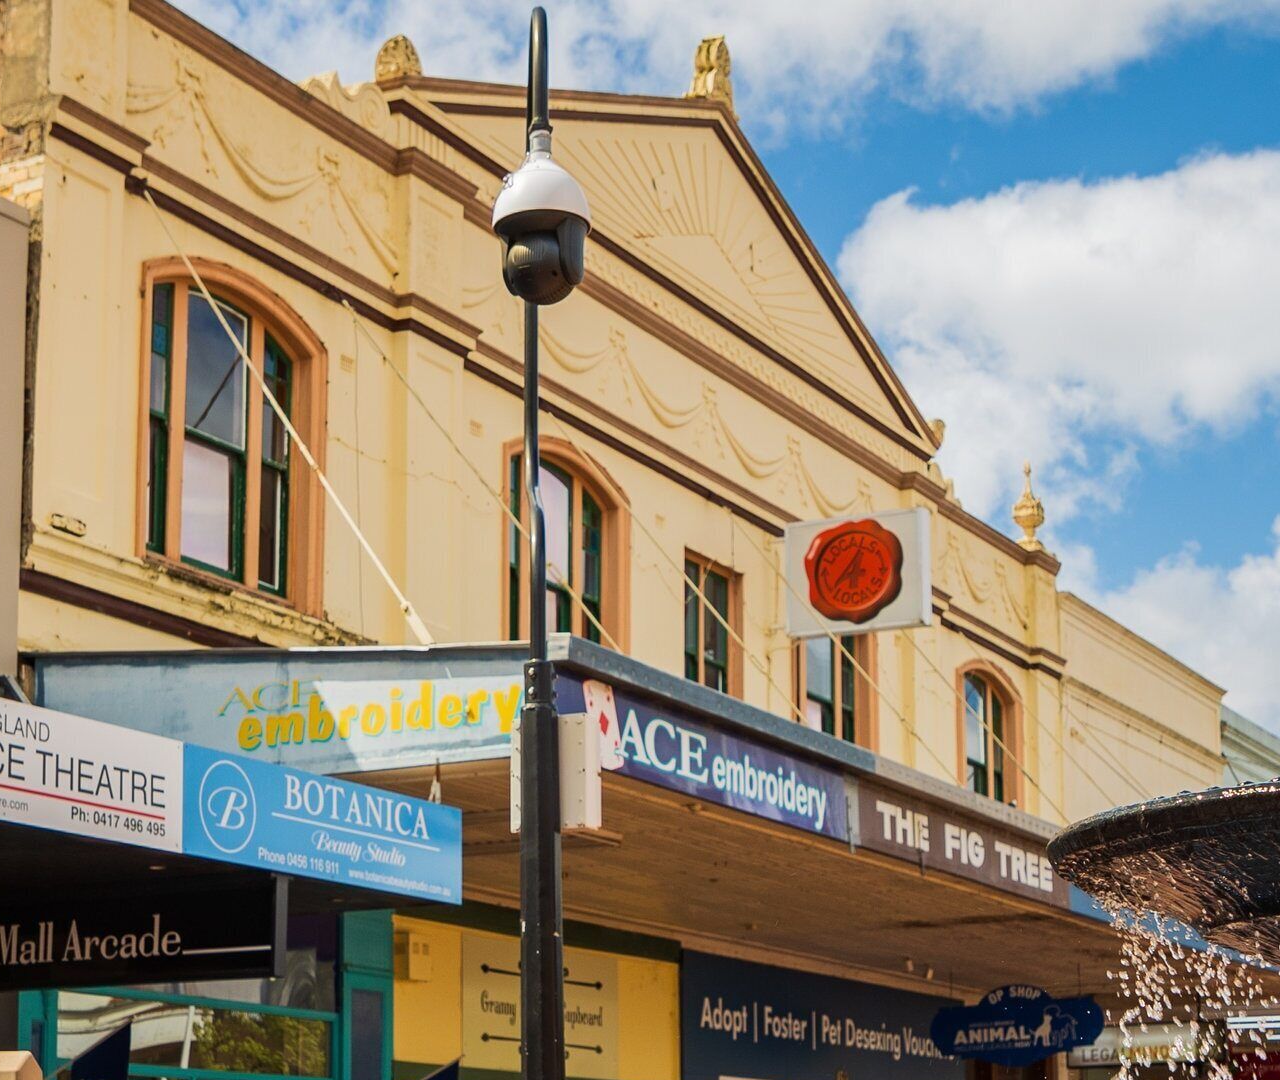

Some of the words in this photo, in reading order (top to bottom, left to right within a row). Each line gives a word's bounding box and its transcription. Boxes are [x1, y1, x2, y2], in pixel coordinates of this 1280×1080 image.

[824, 536, 878, 565] LOCALS
[833, 576, 884, 606] LOCALS
[237, 680, 522, 751] embroidery
[36, 749, 166, 809] THEATRE
[615, 709, 709, 784] ACE
[712, 754, 827, 831] embroidery
[70, 806, 90, 823] Ph:
[93, 811, 120, 829] 0417
[123, 815, 144, 833] 496
[146, 819, 166, 837] 495
[284, 773, 430, 841] BOTANICA
[258, 847, 285, 866] Phone
[325, 861, 340, 875] 911
[311, 830, 362, 863] Beauty
[366, 841, 407, 868] Studio
[876, 800, 930, 852] THE
[944, 822, 985, 868] FIG
[994, 841, 1054, 893] TREE
[61, 913, 181, 962] Arcade
[480, 989, 517, 1026] Granny
[988, 988, 1005, 1006] OP
[1009, 985, 1042, 1001] SHOP
[564, 1004, 603, 1030] upboard
[700, 997, 748, 1041] Adopt
[764, 1005, 807, 1041] Foster
[822, 1014, 842, 1046] Pet
[845, 1018, 901, 1061] Desexing
[953, 1024, 1031, 1046] ANIMAL
